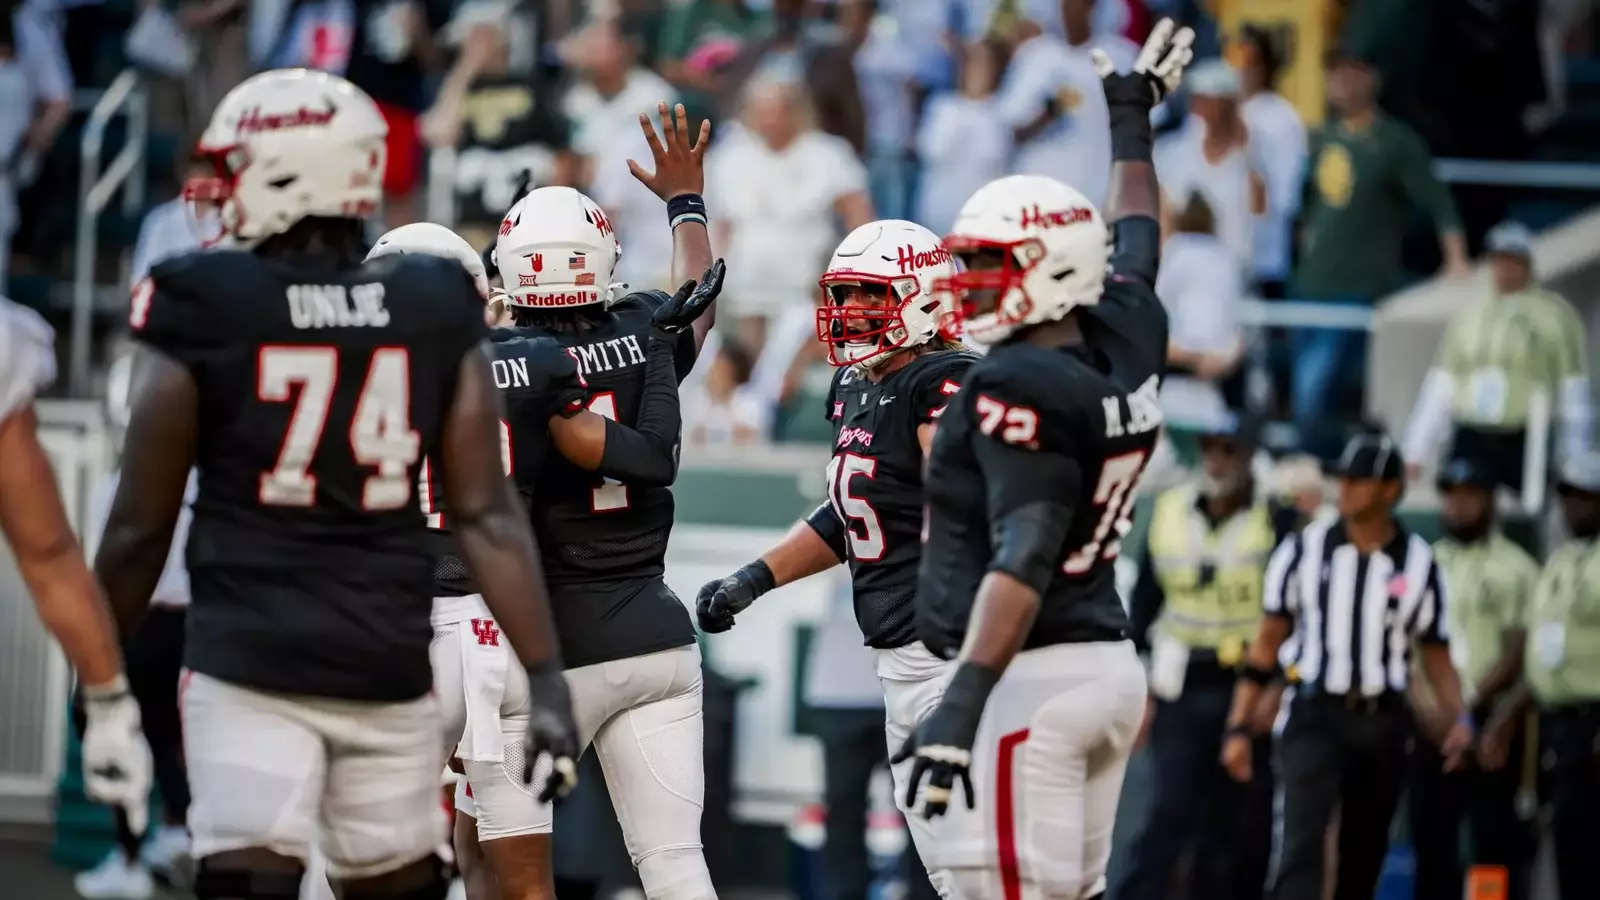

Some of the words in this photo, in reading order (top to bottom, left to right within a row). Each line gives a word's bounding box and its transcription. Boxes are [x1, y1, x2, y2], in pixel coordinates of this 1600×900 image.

[526, 291, 587, 306] Riddell
[257, 345, 421, 509] 74
[975, 393, 1040, 447] 72
